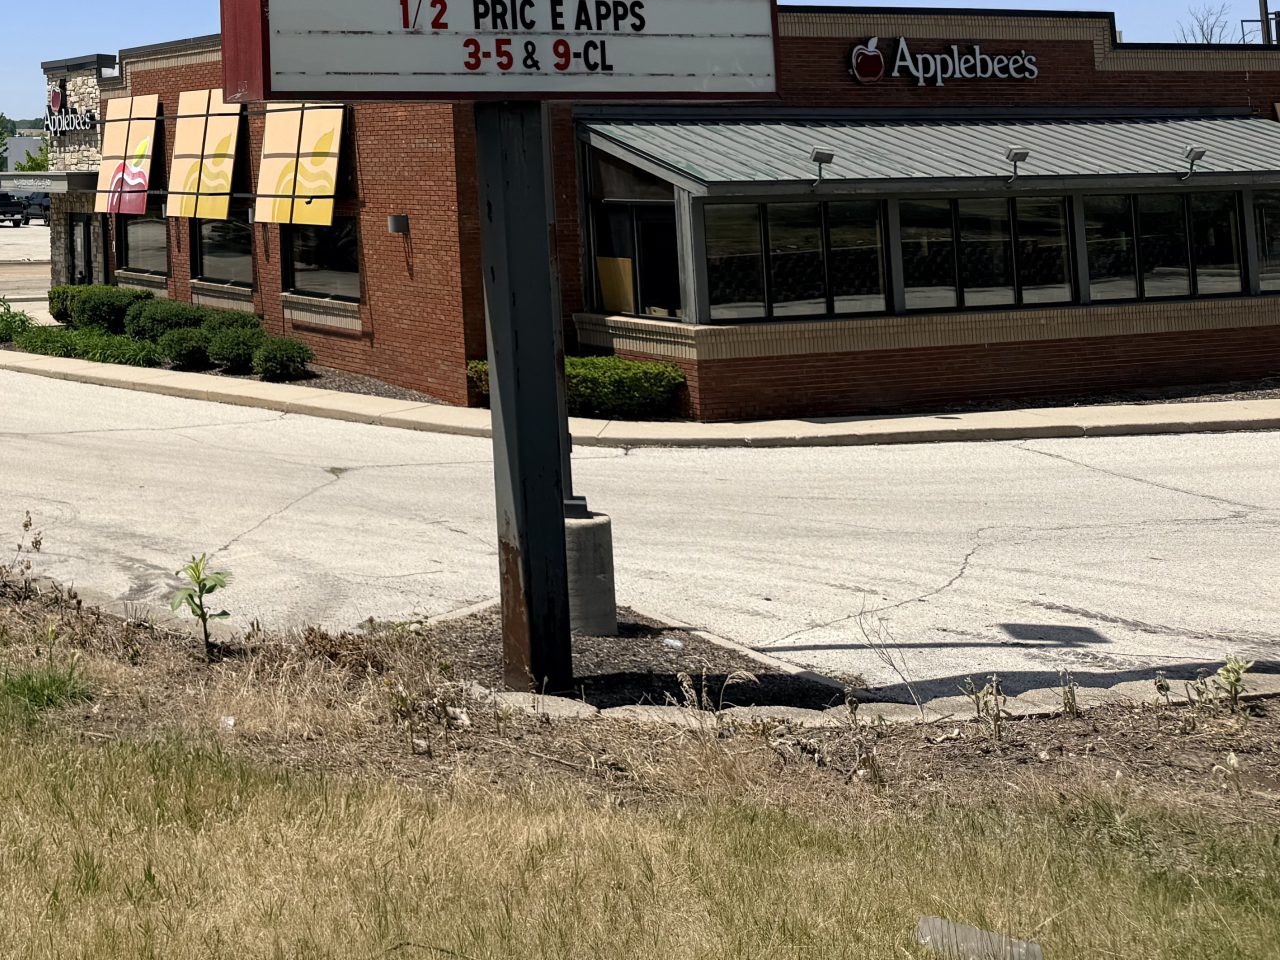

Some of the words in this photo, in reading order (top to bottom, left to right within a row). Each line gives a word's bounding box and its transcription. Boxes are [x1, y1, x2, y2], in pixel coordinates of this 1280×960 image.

[574, 0, 646, 32] APPS
[462, 38, 514, 72] 3-5
[522, 40, 541, 72] &
[552, 38, 614, 72] 9-CL
[891, 36, 1039, 87] Applebee's
